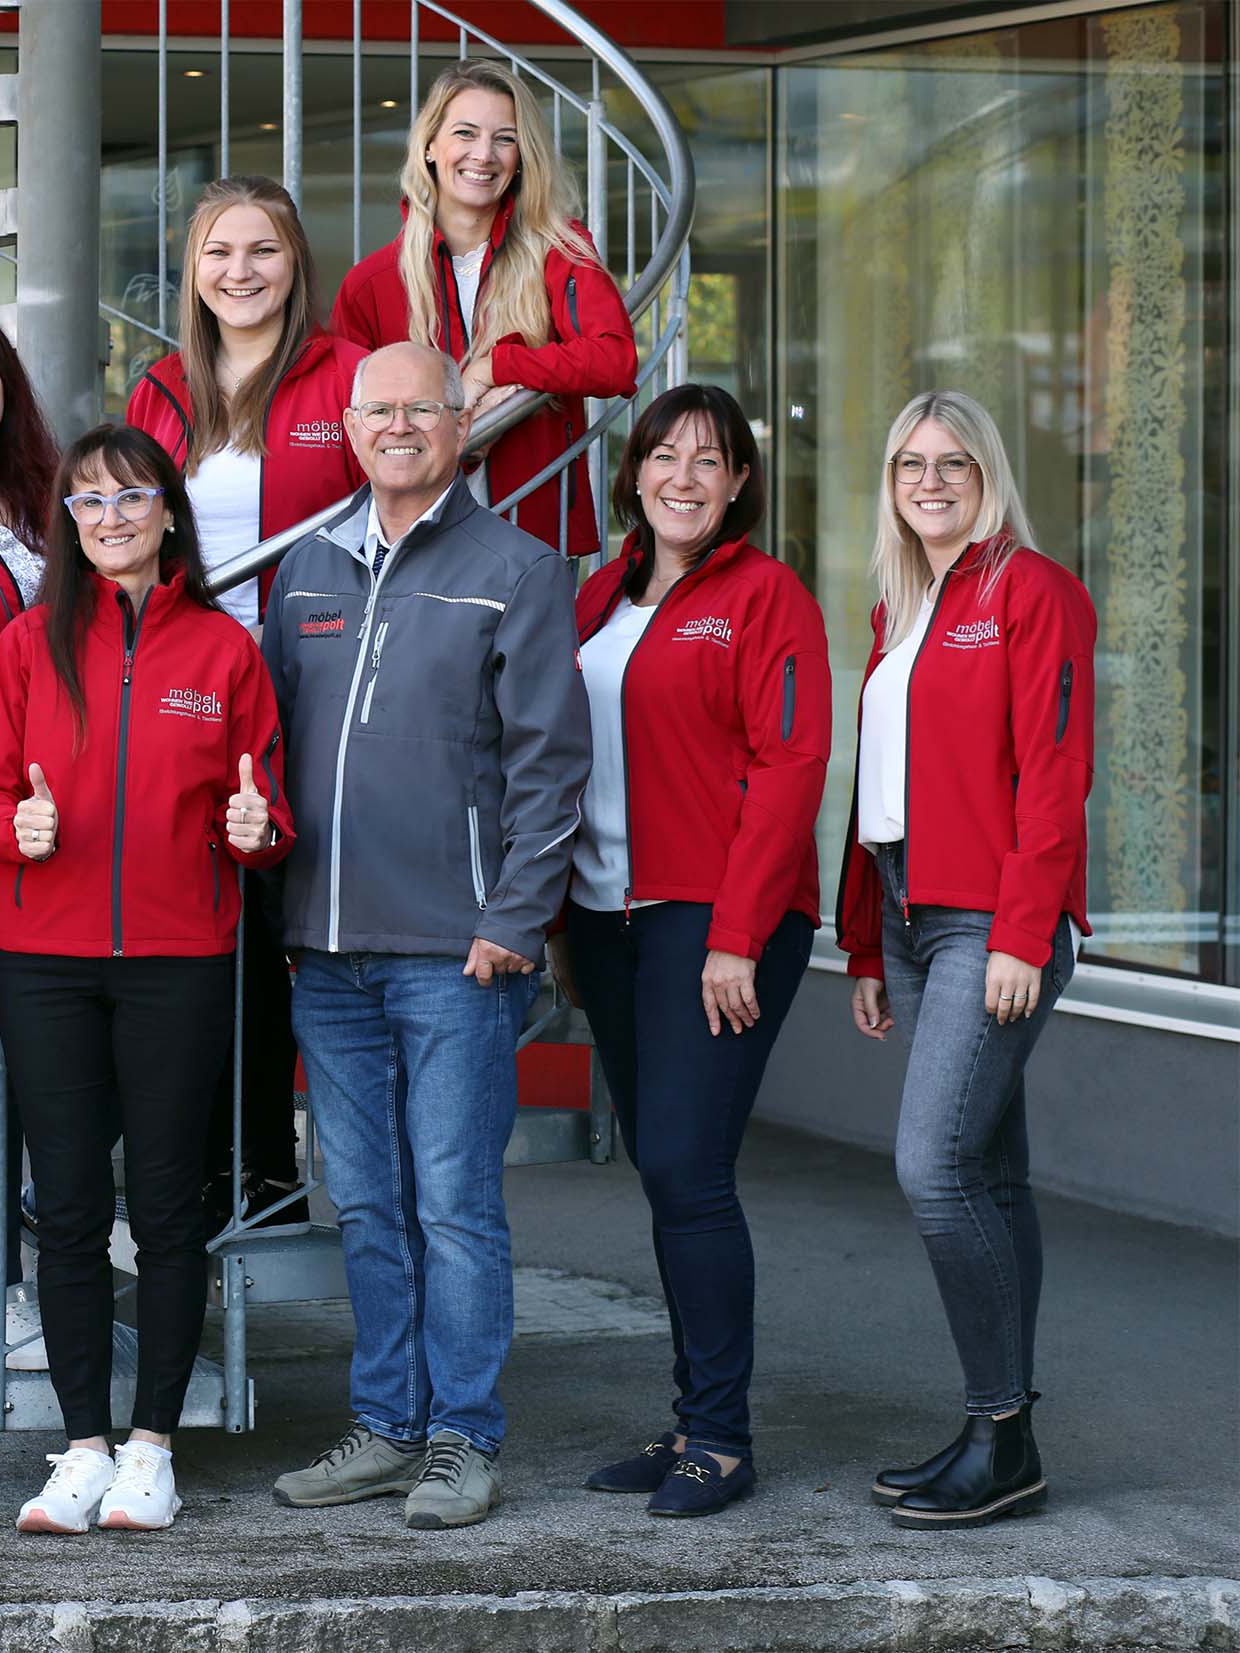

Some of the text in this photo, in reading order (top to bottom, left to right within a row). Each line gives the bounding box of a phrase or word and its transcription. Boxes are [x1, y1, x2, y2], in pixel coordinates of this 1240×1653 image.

[322, 431, 343, 443] pol
[308, 610, 342, 622] möbel
[685, 616, 729, 628] möbel
[321, 619, 344, 632] polt
[956, 616, 995, 634] möbel
[703, 625, 732, 641] polt
[975, 624, 1000, 644] polt
[169, 687, 216, 705] möbel
[193, 700, 222, 715] polt
